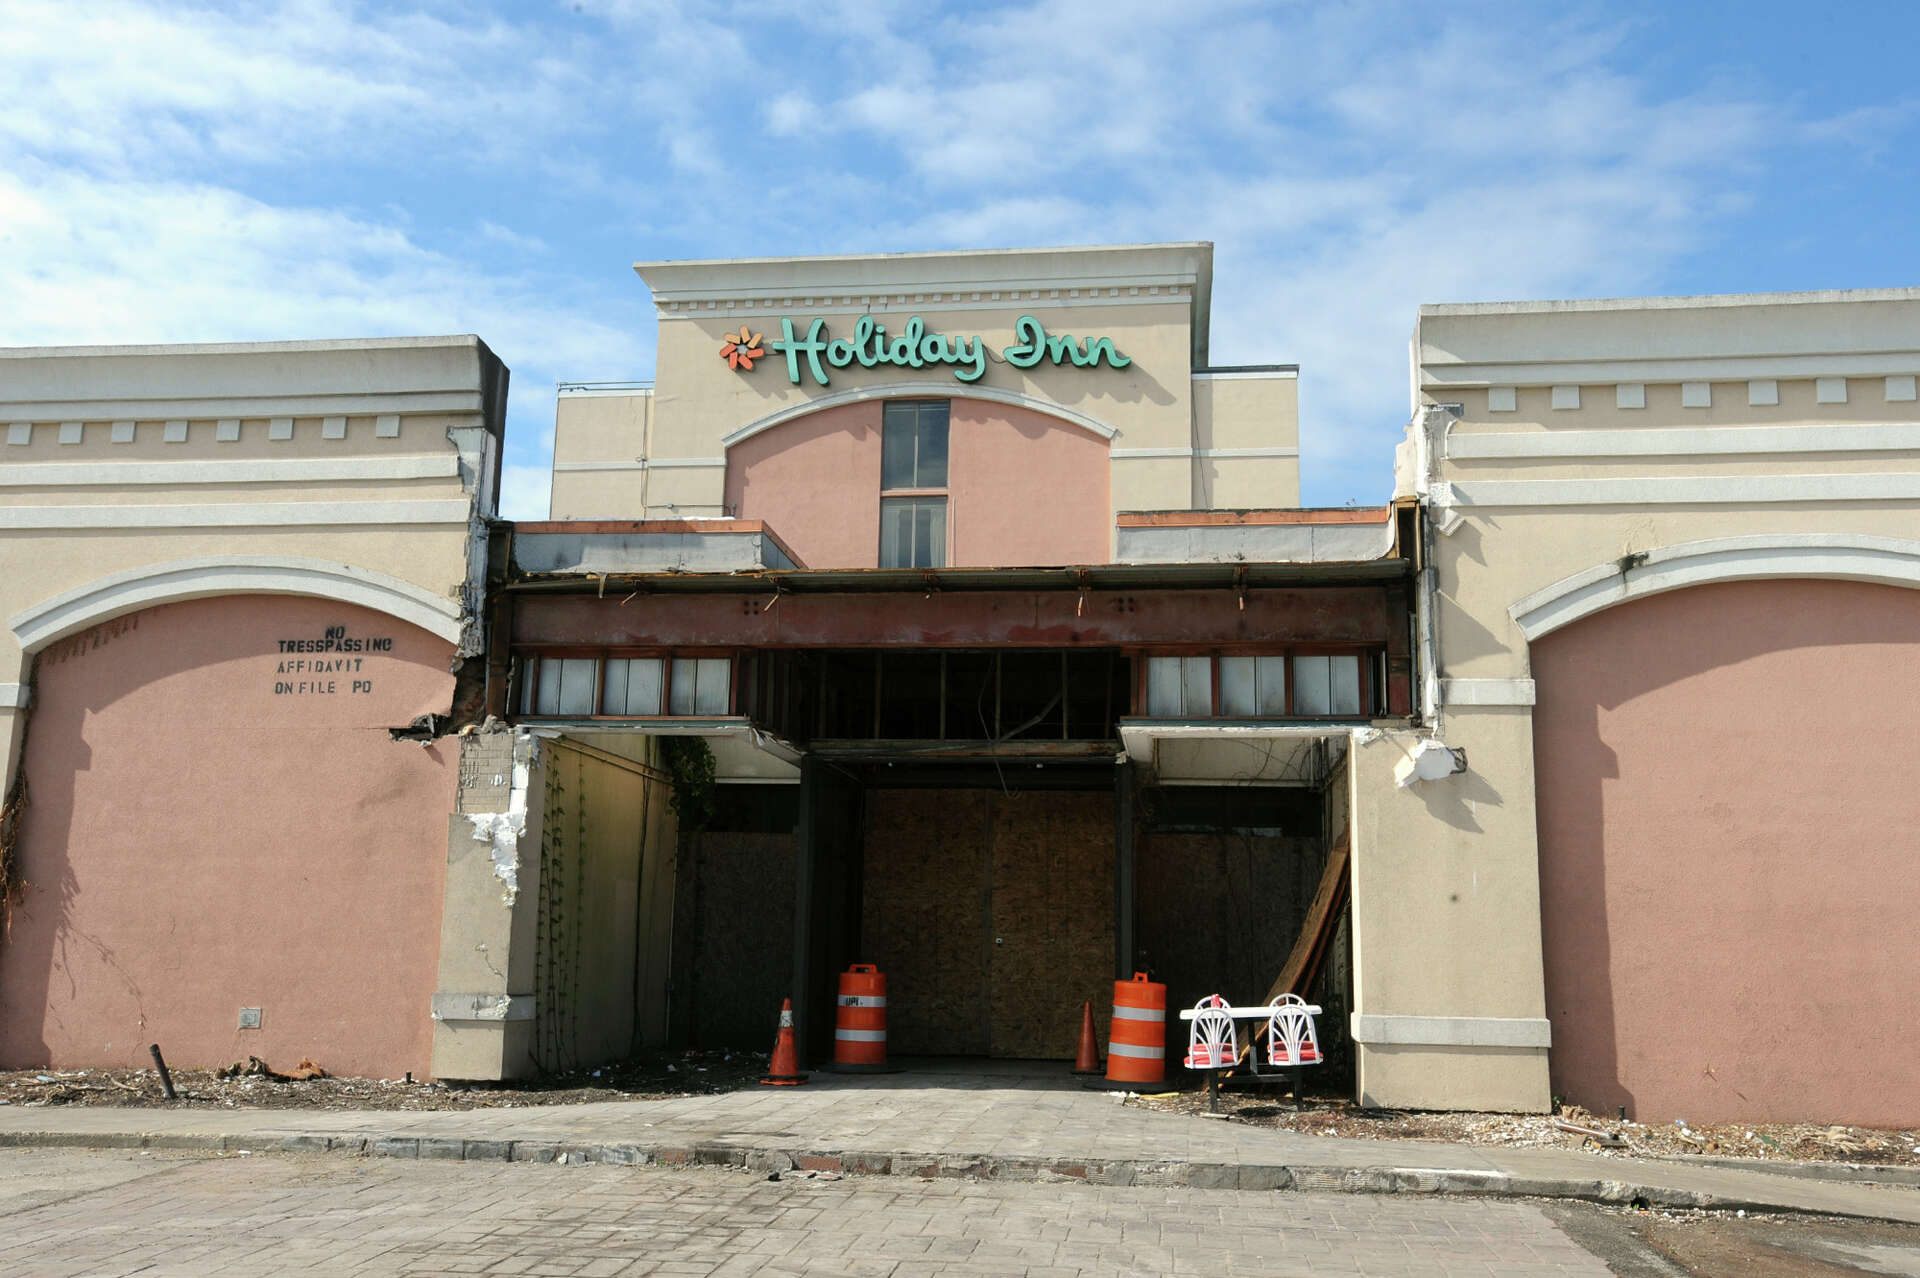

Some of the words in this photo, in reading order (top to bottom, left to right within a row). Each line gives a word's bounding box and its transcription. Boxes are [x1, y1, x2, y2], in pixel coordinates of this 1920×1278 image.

[772, 315, 986, 386] Holiday
[1003, 315, 1132, 369] Inn
[325, 626, 345, 639] NO
[277, 659, 363, 673] AFFIDAVIT
